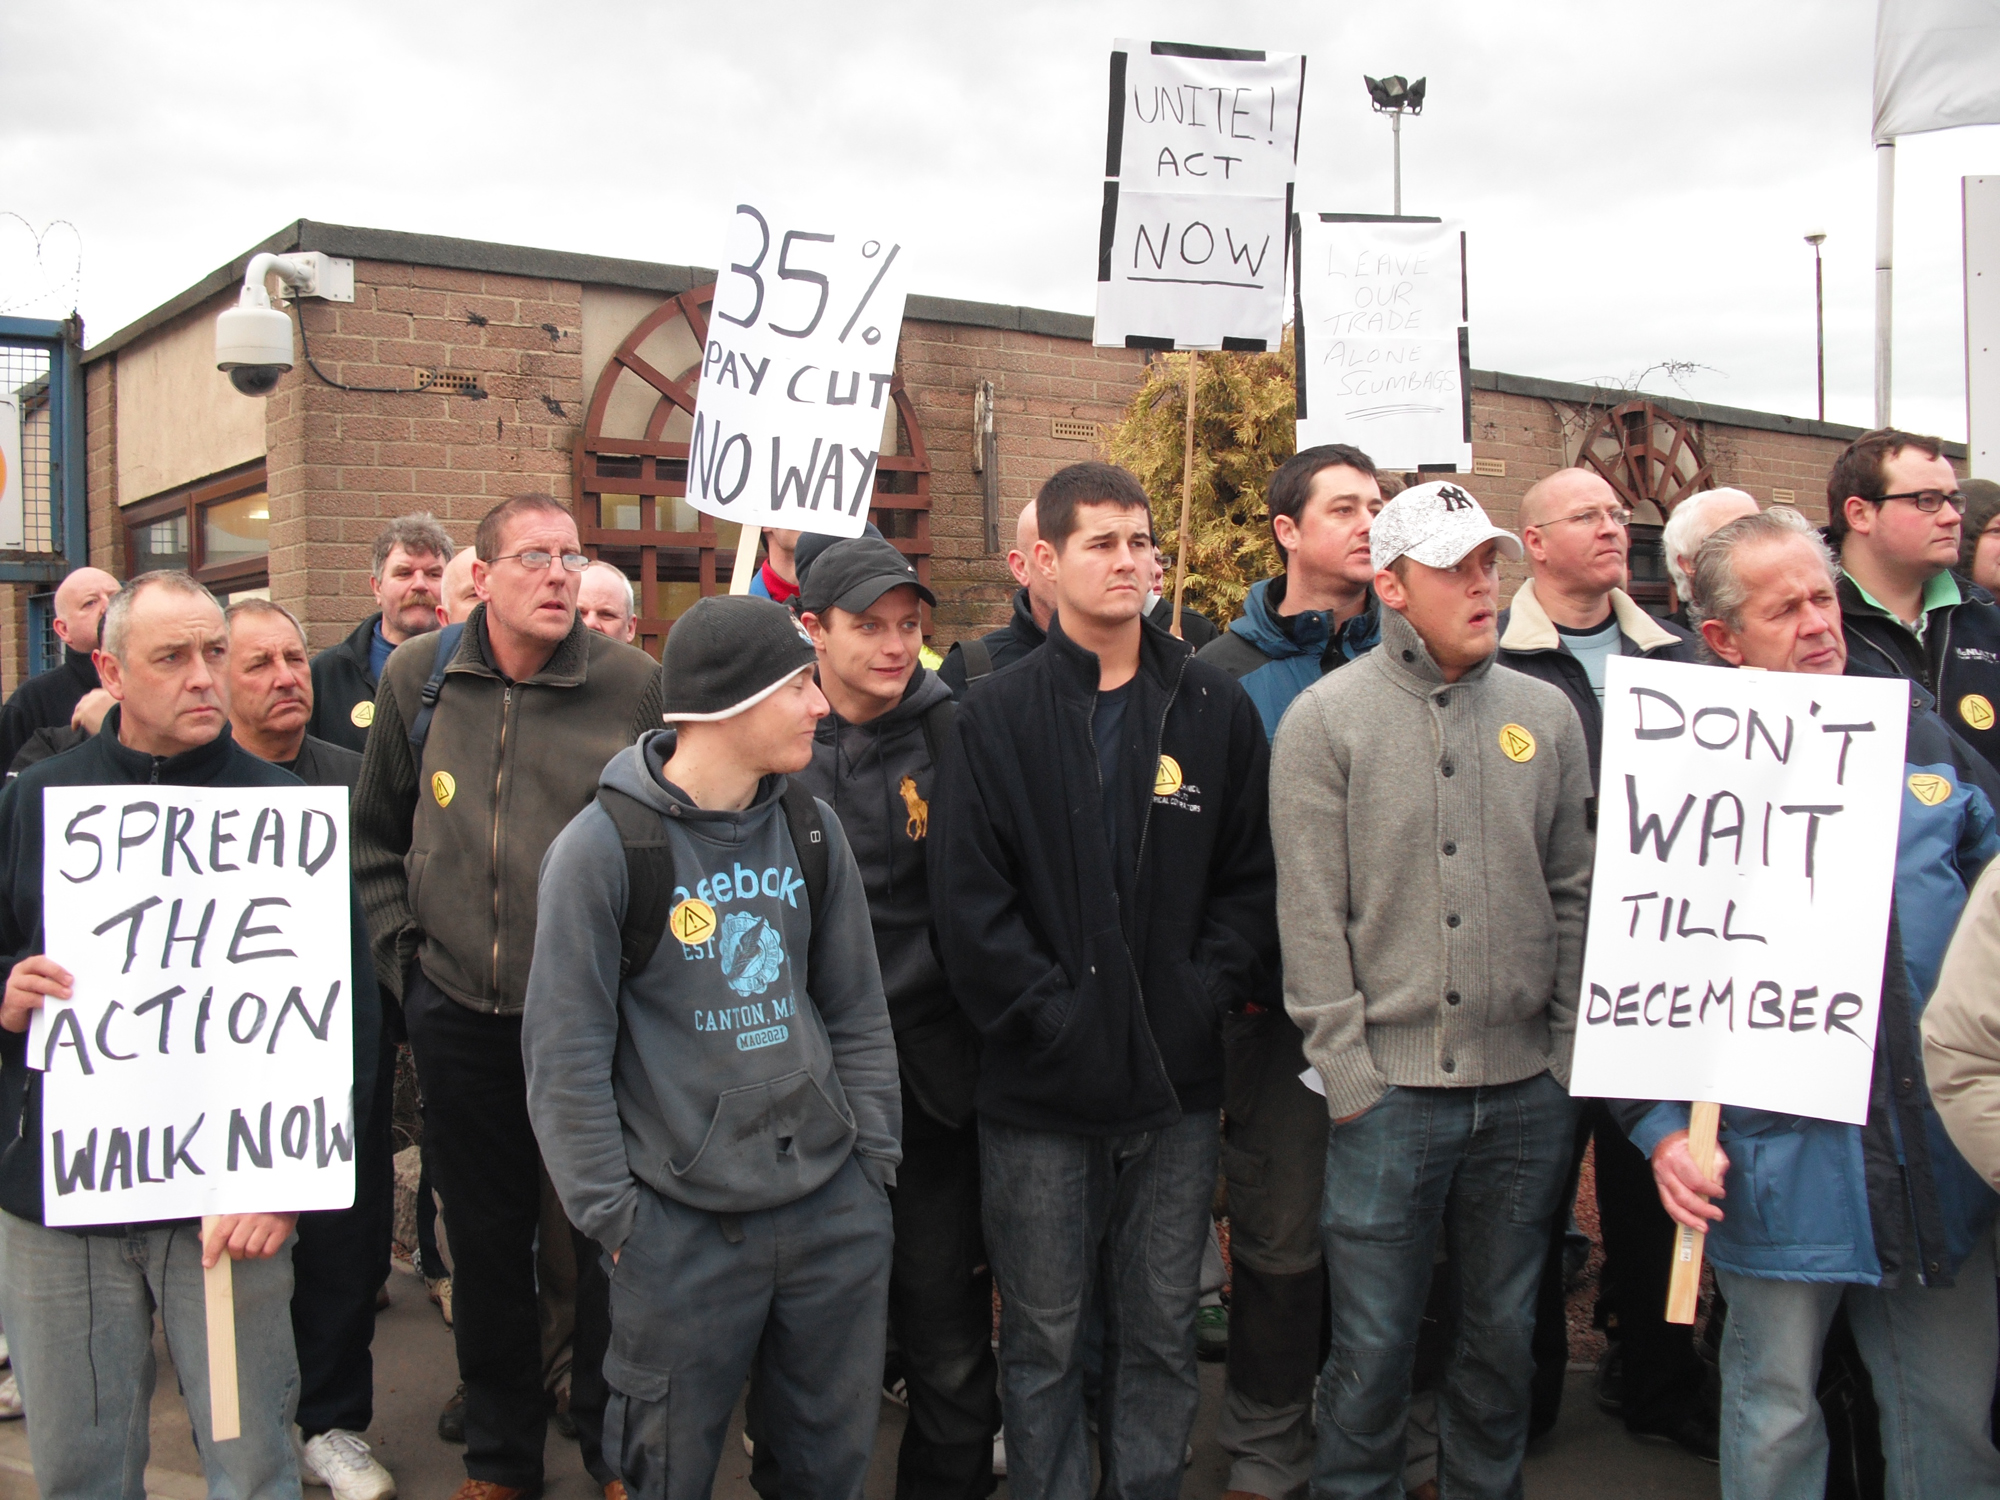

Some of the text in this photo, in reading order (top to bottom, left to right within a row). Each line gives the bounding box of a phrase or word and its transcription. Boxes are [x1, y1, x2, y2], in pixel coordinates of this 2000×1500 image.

[1134, 84, 1275, 145] UNITE!
[1158, 146, 1243, 179] ACT
[718, 204, 902, 346] 35%
[1134, 220, 1270, 277] NOW
[1328, 243, 1430, 279] LEAVE
[1323, 308, 1423, 336] TRADE
[1355, 281, 1414, 309] OUR
[703, 340, 893, 409] PAY CUT
[1323, 340, 1423, 367] ALONE
[1337, 370, 1456, 397] SCUMBAGS
[688, 410, 879, 517] NO WAY
[1437, 485, 1474, 511] NY
[1629, 687, 1877, 786] DON'T
[60, 801, 338, 884] SPREAD
[1624, 774, 1845, 900] WAIT
[91, 895, 298, 974] THE
[1621, 891, 1768, 944] TILL
[43, 980, 342, 1075] ACTION
[694, 1002, 771, 1032] CANTON,
[739, 1027, 787, 1050] MA02021
[1585, 976, 1875, 1052] DECEMBER
[52, 1085, 354, 1197] WALK NOW
